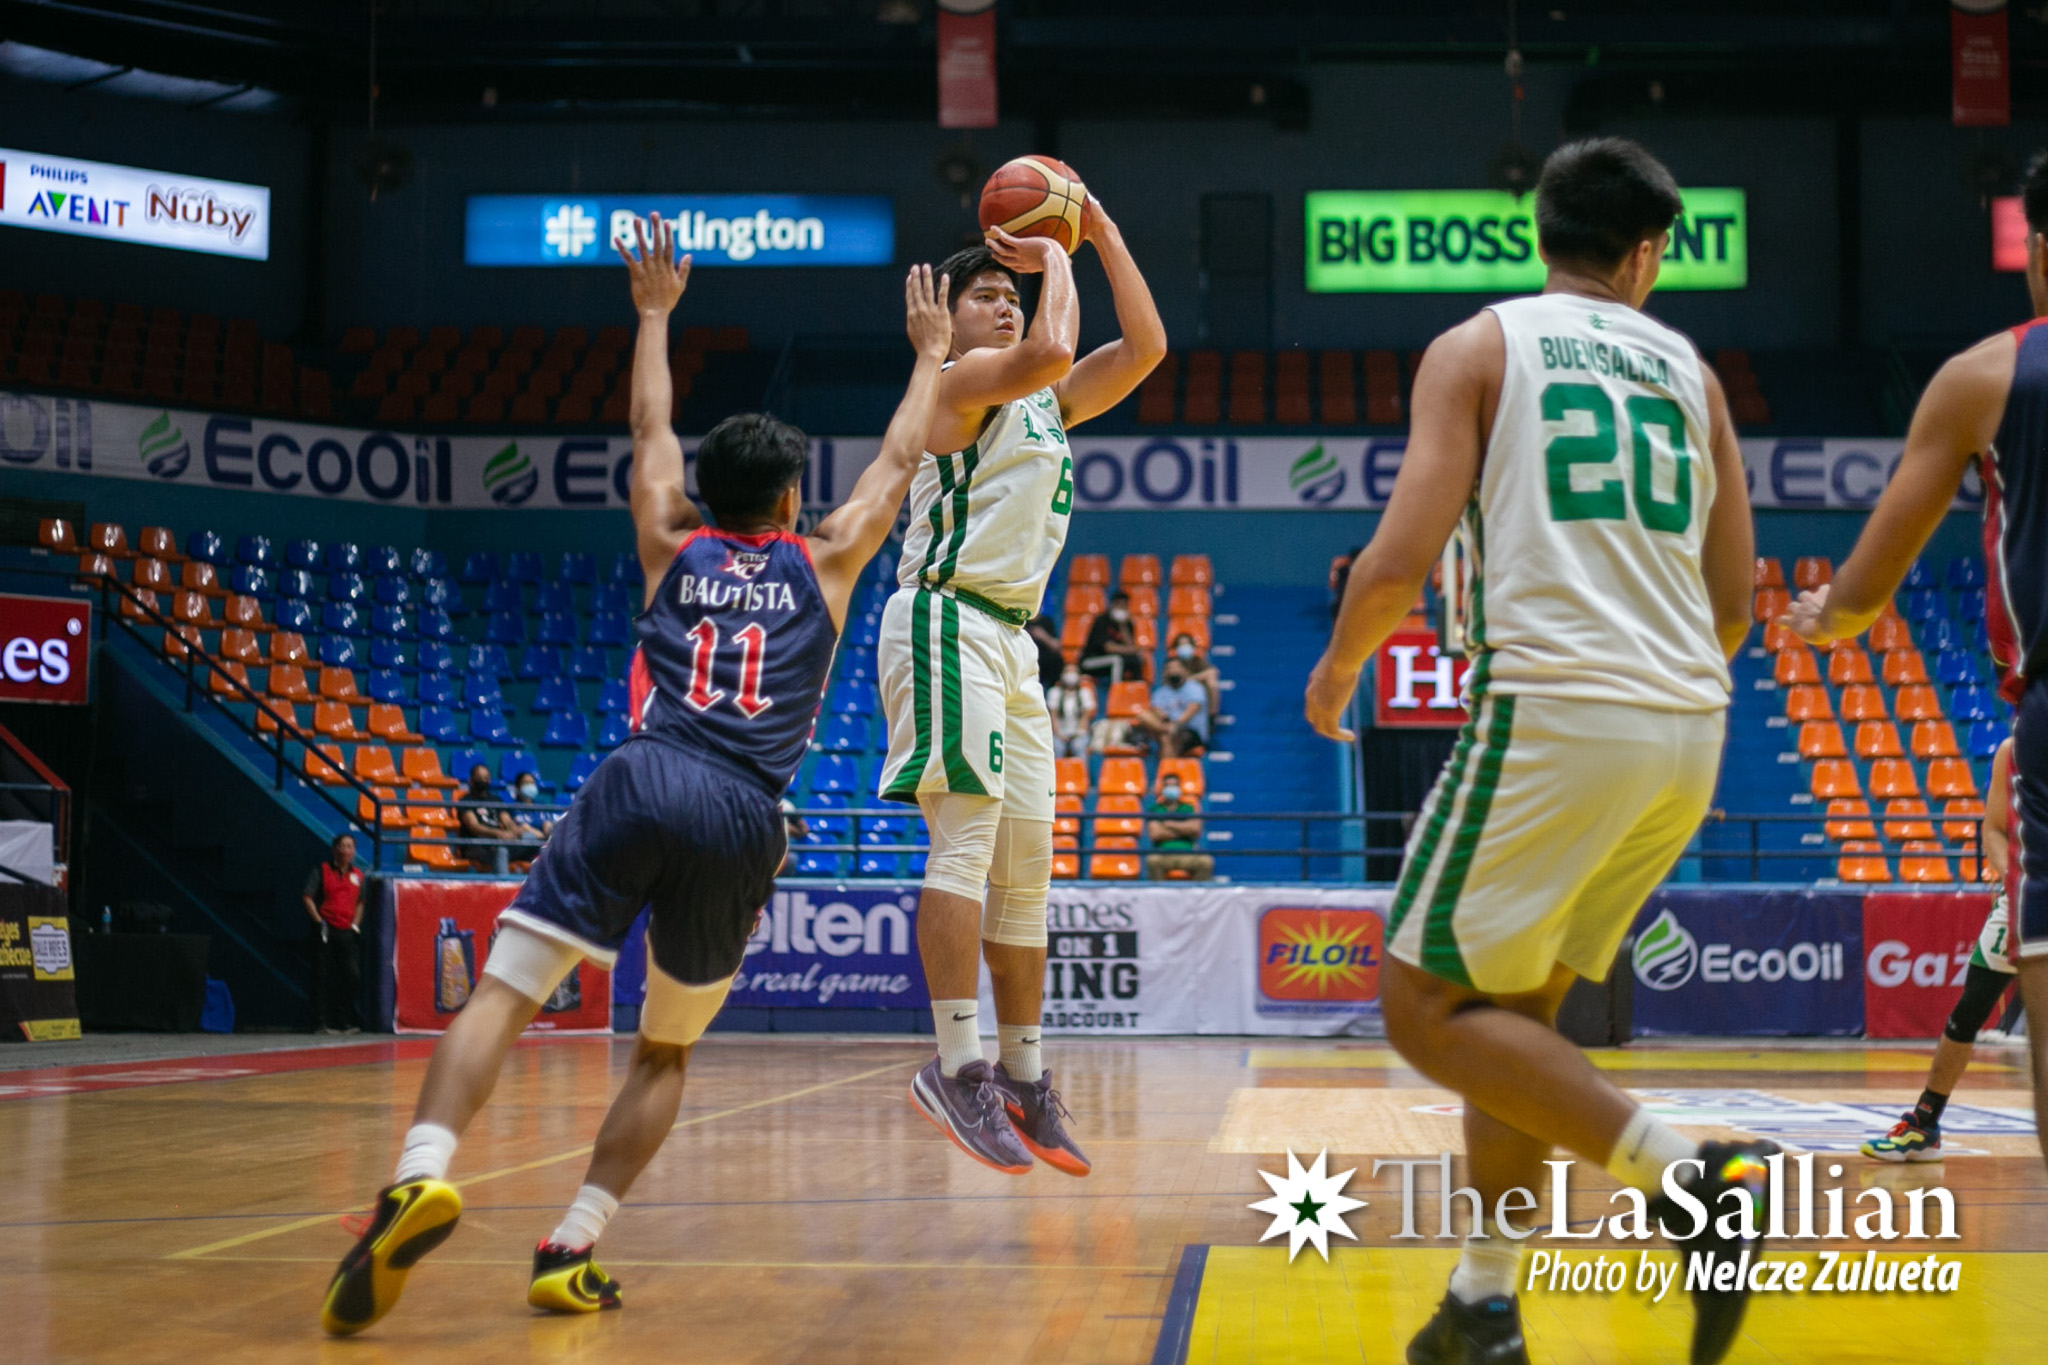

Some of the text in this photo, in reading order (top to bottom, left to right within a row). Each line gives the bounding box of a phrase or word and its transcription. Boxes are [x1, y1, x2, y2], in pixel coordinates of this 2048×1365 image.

[30, 164, 88, 184] PHILIPS
[27, 190, 130, 228] AVENT
[610, 209, 824, 261] Burlington
[1319, 218, 1396, 263] BIG
[1408, 216, 1531, 262] BOSS
[204, 415, 452, 502] EcoOil
[1541, 382, 1690, 533] 20
[1051, 456, 1073, 516] 6
[680, 574, 797, 611] BAUTISTA
[685, 616, 773, 719] 11
[989, 730, 1003, 774] 6
[1103, 933, 1119, 957] 1
[1266, 942, 1378, 967] FILOIL
[1701, 942, 1843, 982] EcoOil
[750, 962, 822, 991] real
[818, 971, 912, 1004] game
[1043, 963, 1138, 999] ING
